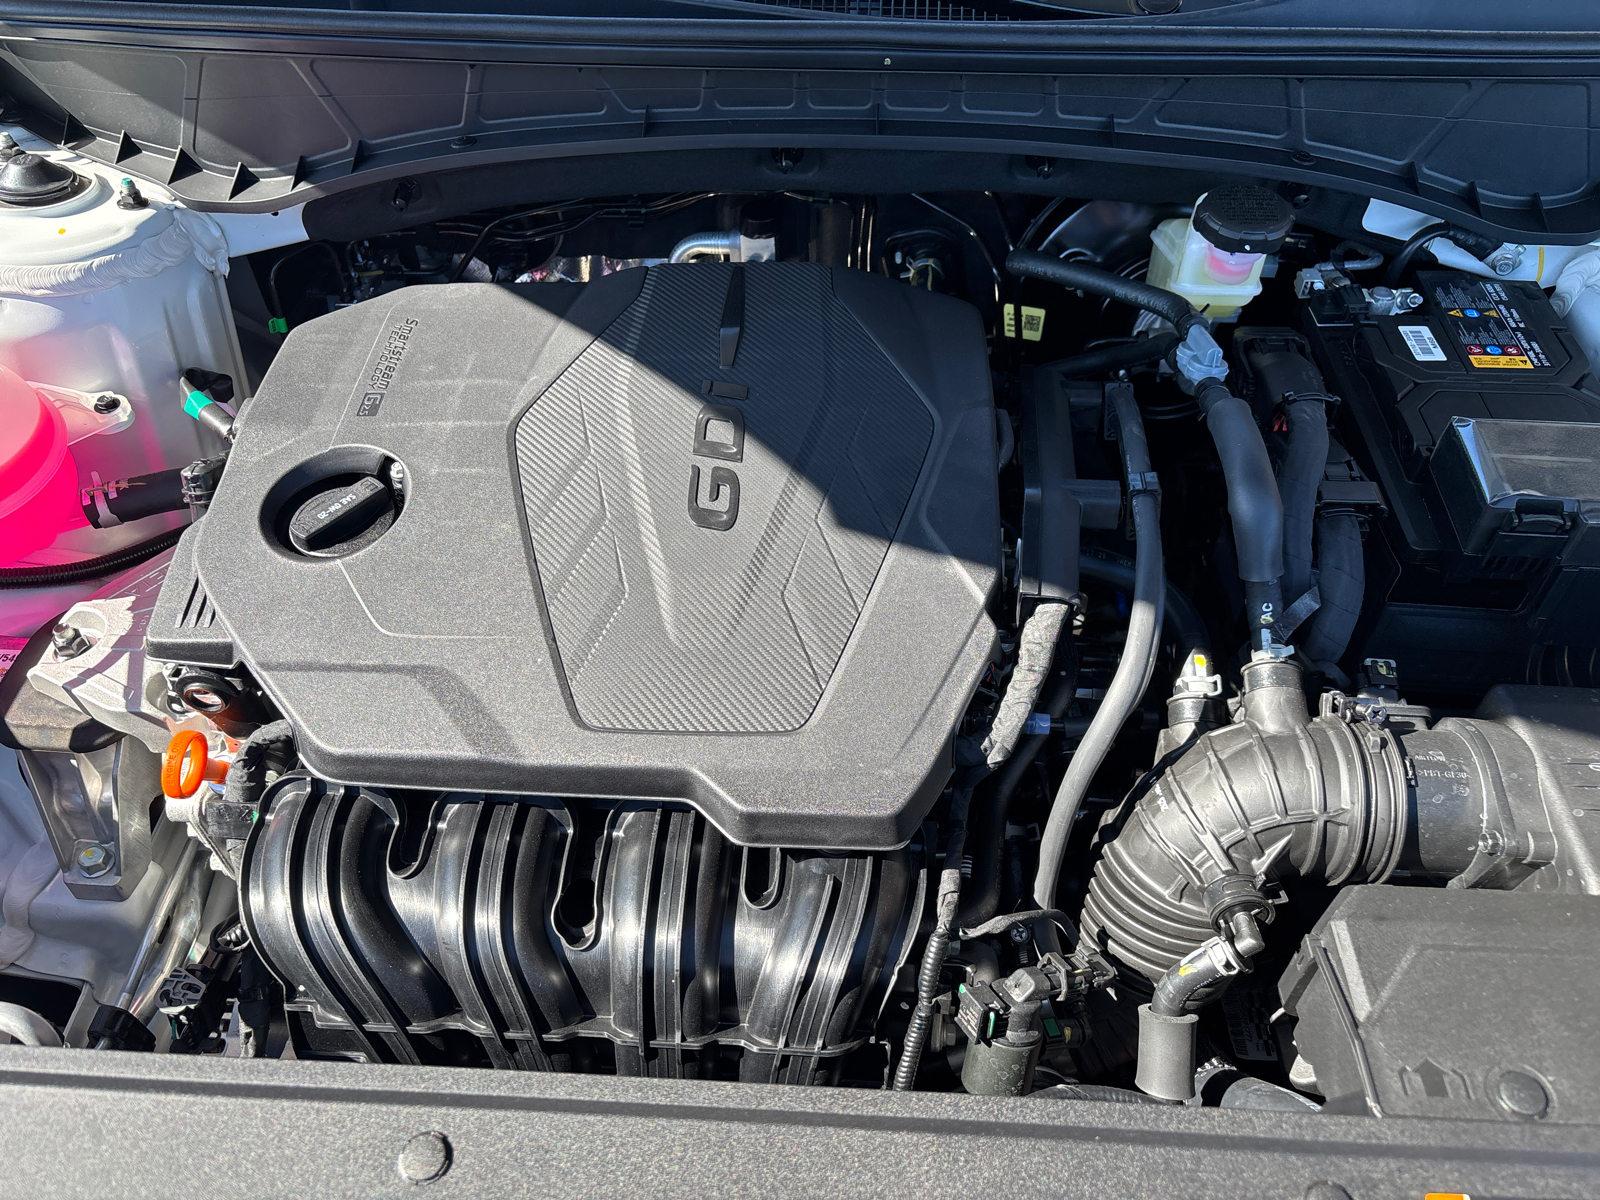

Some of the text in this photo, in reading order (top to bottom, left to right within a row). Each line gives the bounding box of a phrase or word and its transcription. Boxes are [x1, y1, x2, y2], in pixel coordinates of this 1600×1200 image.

[368, 324, 403, 391] TECHNOLOGY
[377, 317, 419, 391] Smartstream
[317, 494, 356, 520] SAE 0W-20
[166, 754, 177, 786] ENGINE
